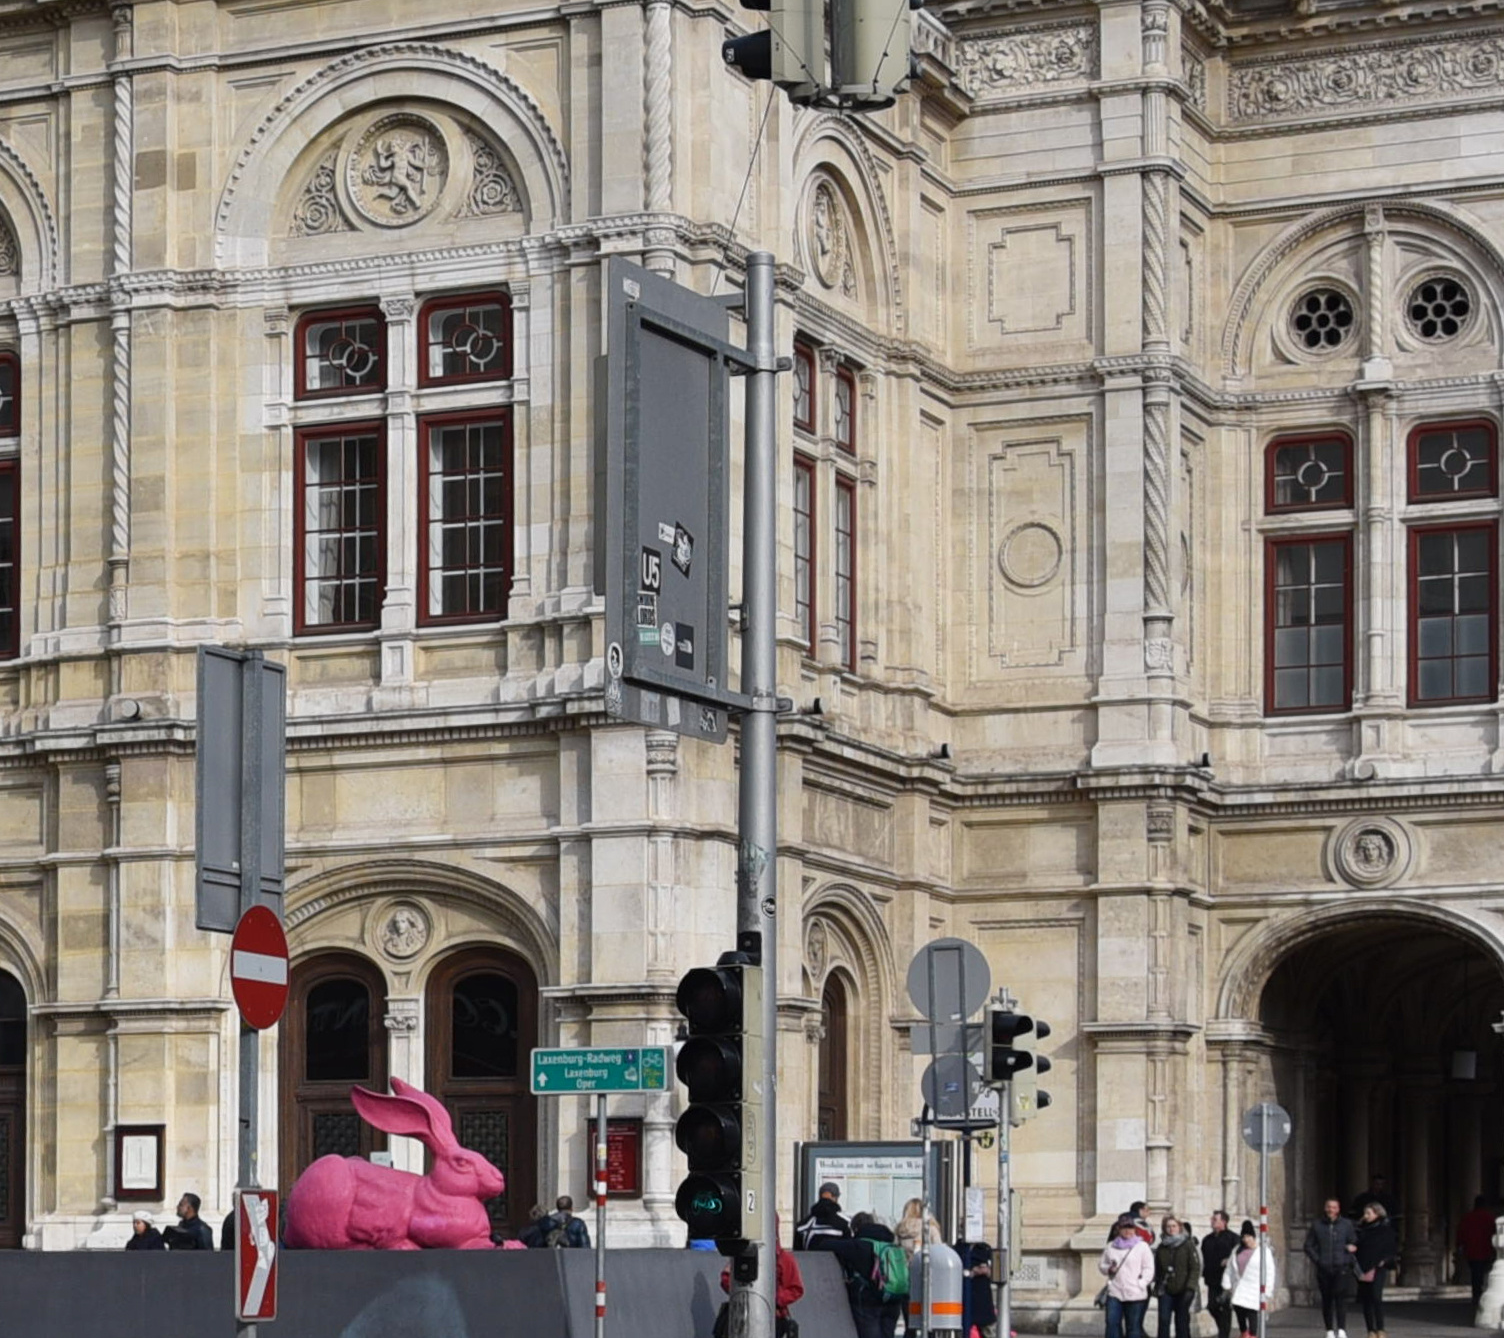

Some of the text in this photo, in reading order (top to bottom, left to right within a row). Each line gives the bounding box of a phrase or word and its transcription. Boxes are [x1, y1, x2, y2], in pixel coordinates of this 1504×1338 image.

[642, 552, 660, 589] U5
[537, 1052, 622, 1067] Laxenburg-Radweg
[564, 1068, 609, 1080] Laxenburg
[576, 1078, 597, 1091] Oper
